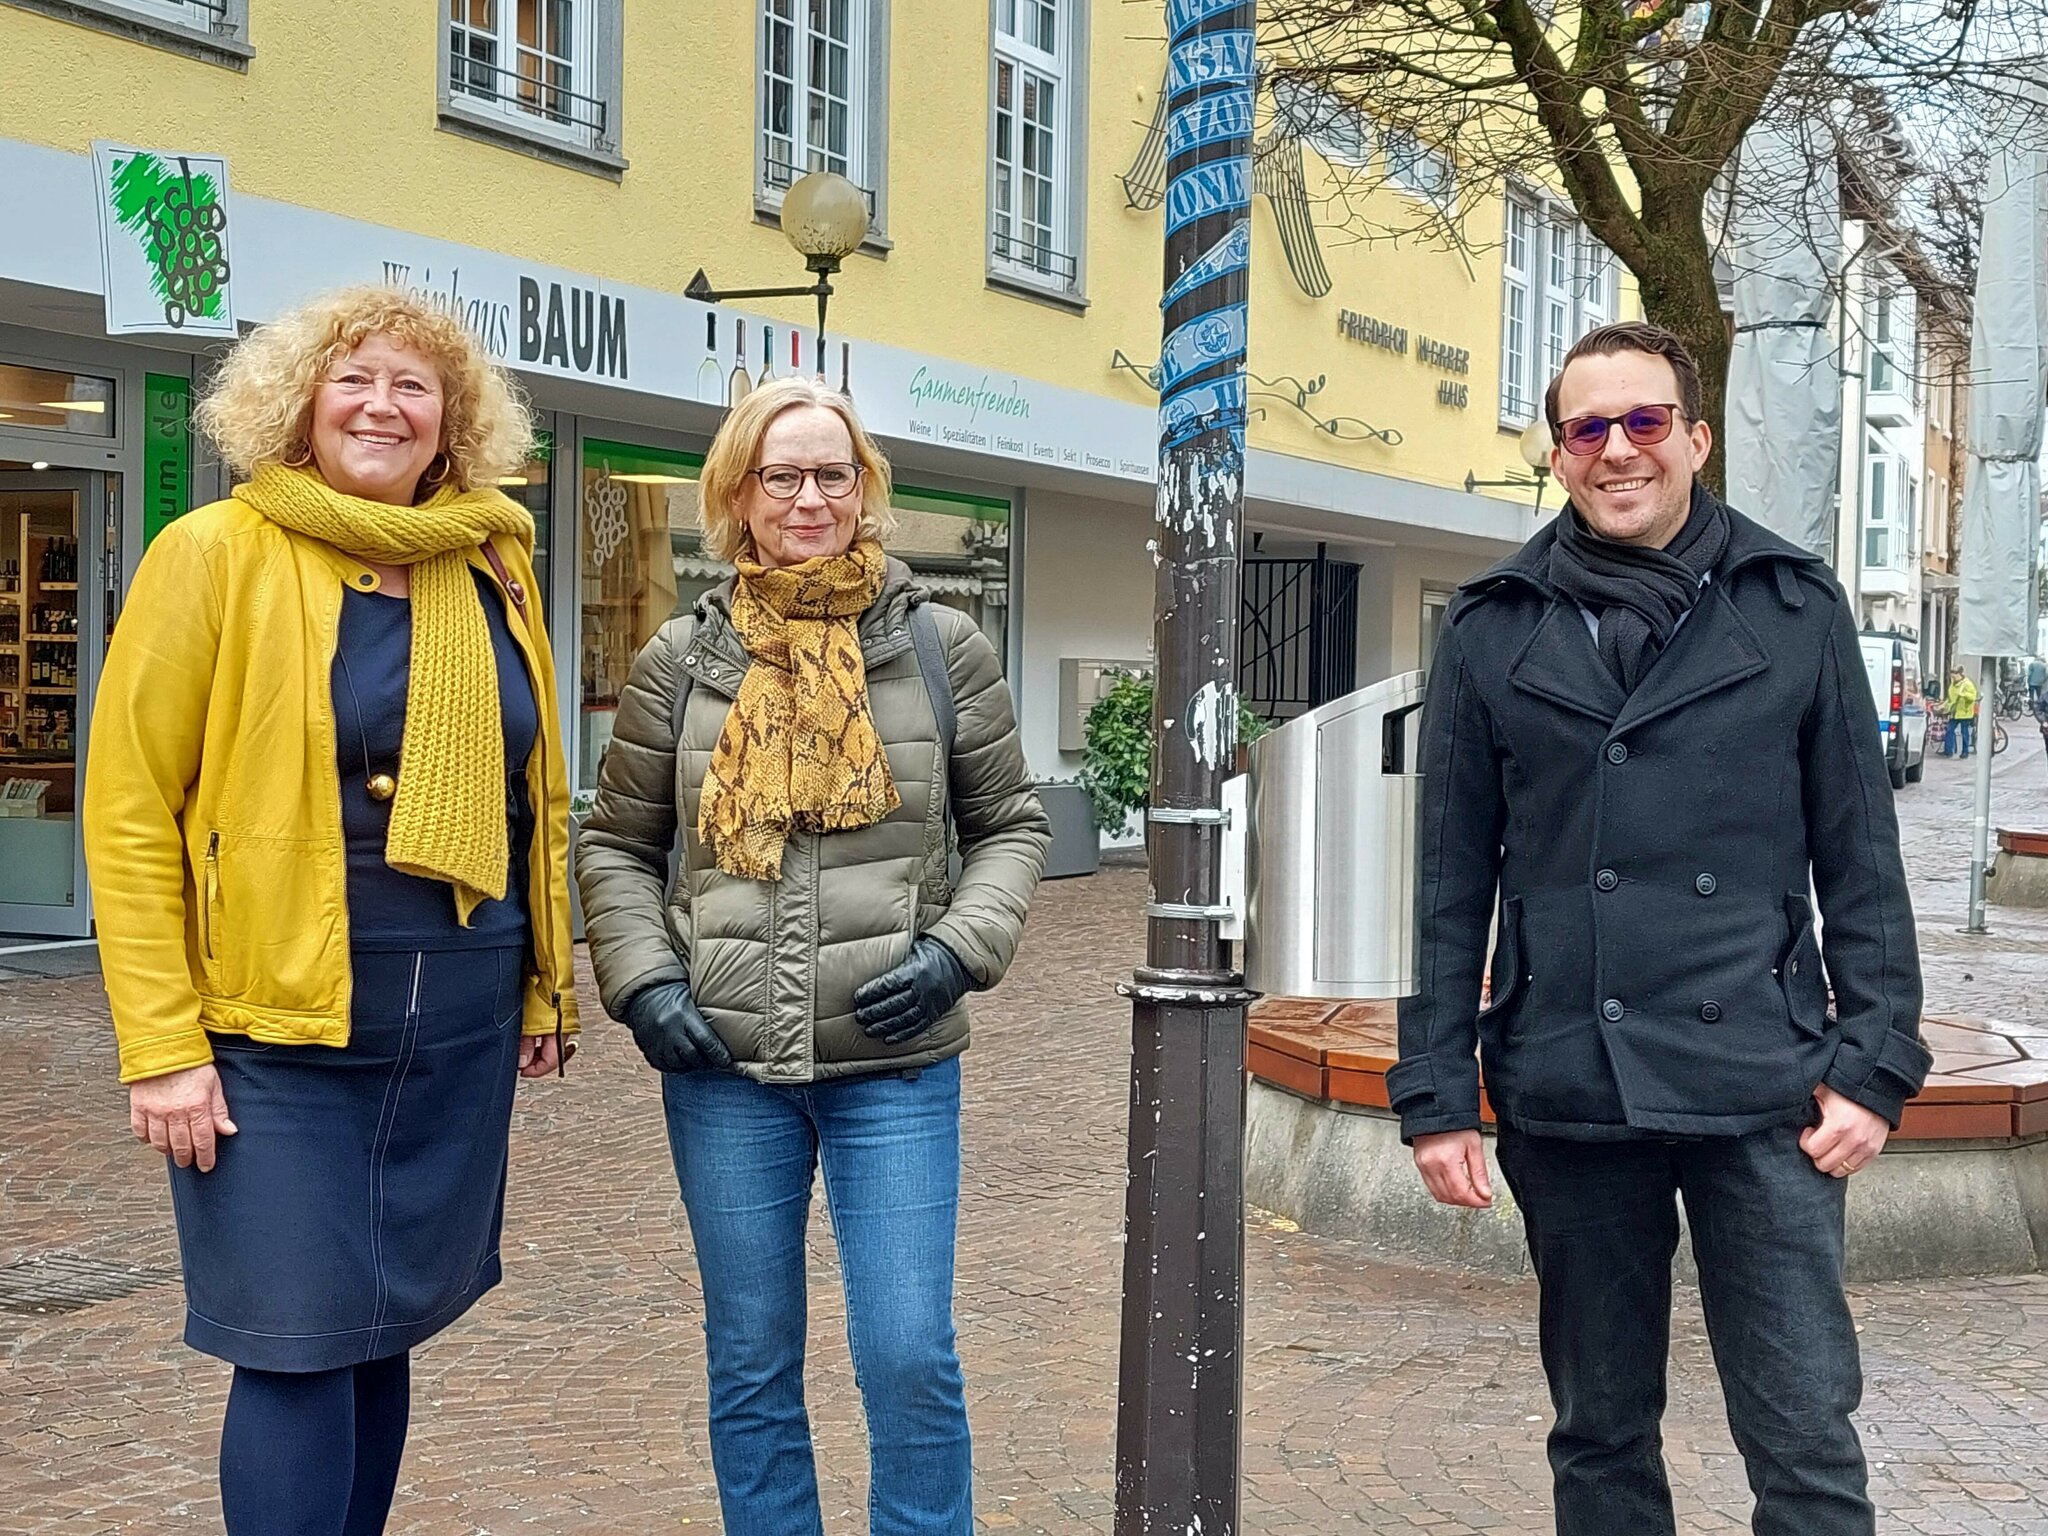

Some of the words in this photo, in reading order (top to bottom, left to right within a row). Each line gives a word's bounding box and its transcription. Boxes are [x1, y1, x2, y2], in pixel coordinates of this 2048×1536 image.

[382, 261, 509, 359] ihaus
[519, 275, 628, 380] BAUM
[1339, 308, 1408, 354] FRIEDRICH
[909, 365, 1030, 424] Gaumenfreuden
[1438, 379, 1469, 409] HAUS
[909, 419, 932, 437] Weine
[942, 426, 987, 447] Spezialitäten
[997, 436, 1024, 453] Feinkost
[1033, 443, 1054, 458] Events
[1063, 448, 1077, 462] Sekt
[1086, 453, 1111, 469] Prosecco
[1120, 459, 1150, 476] Spirituosen
